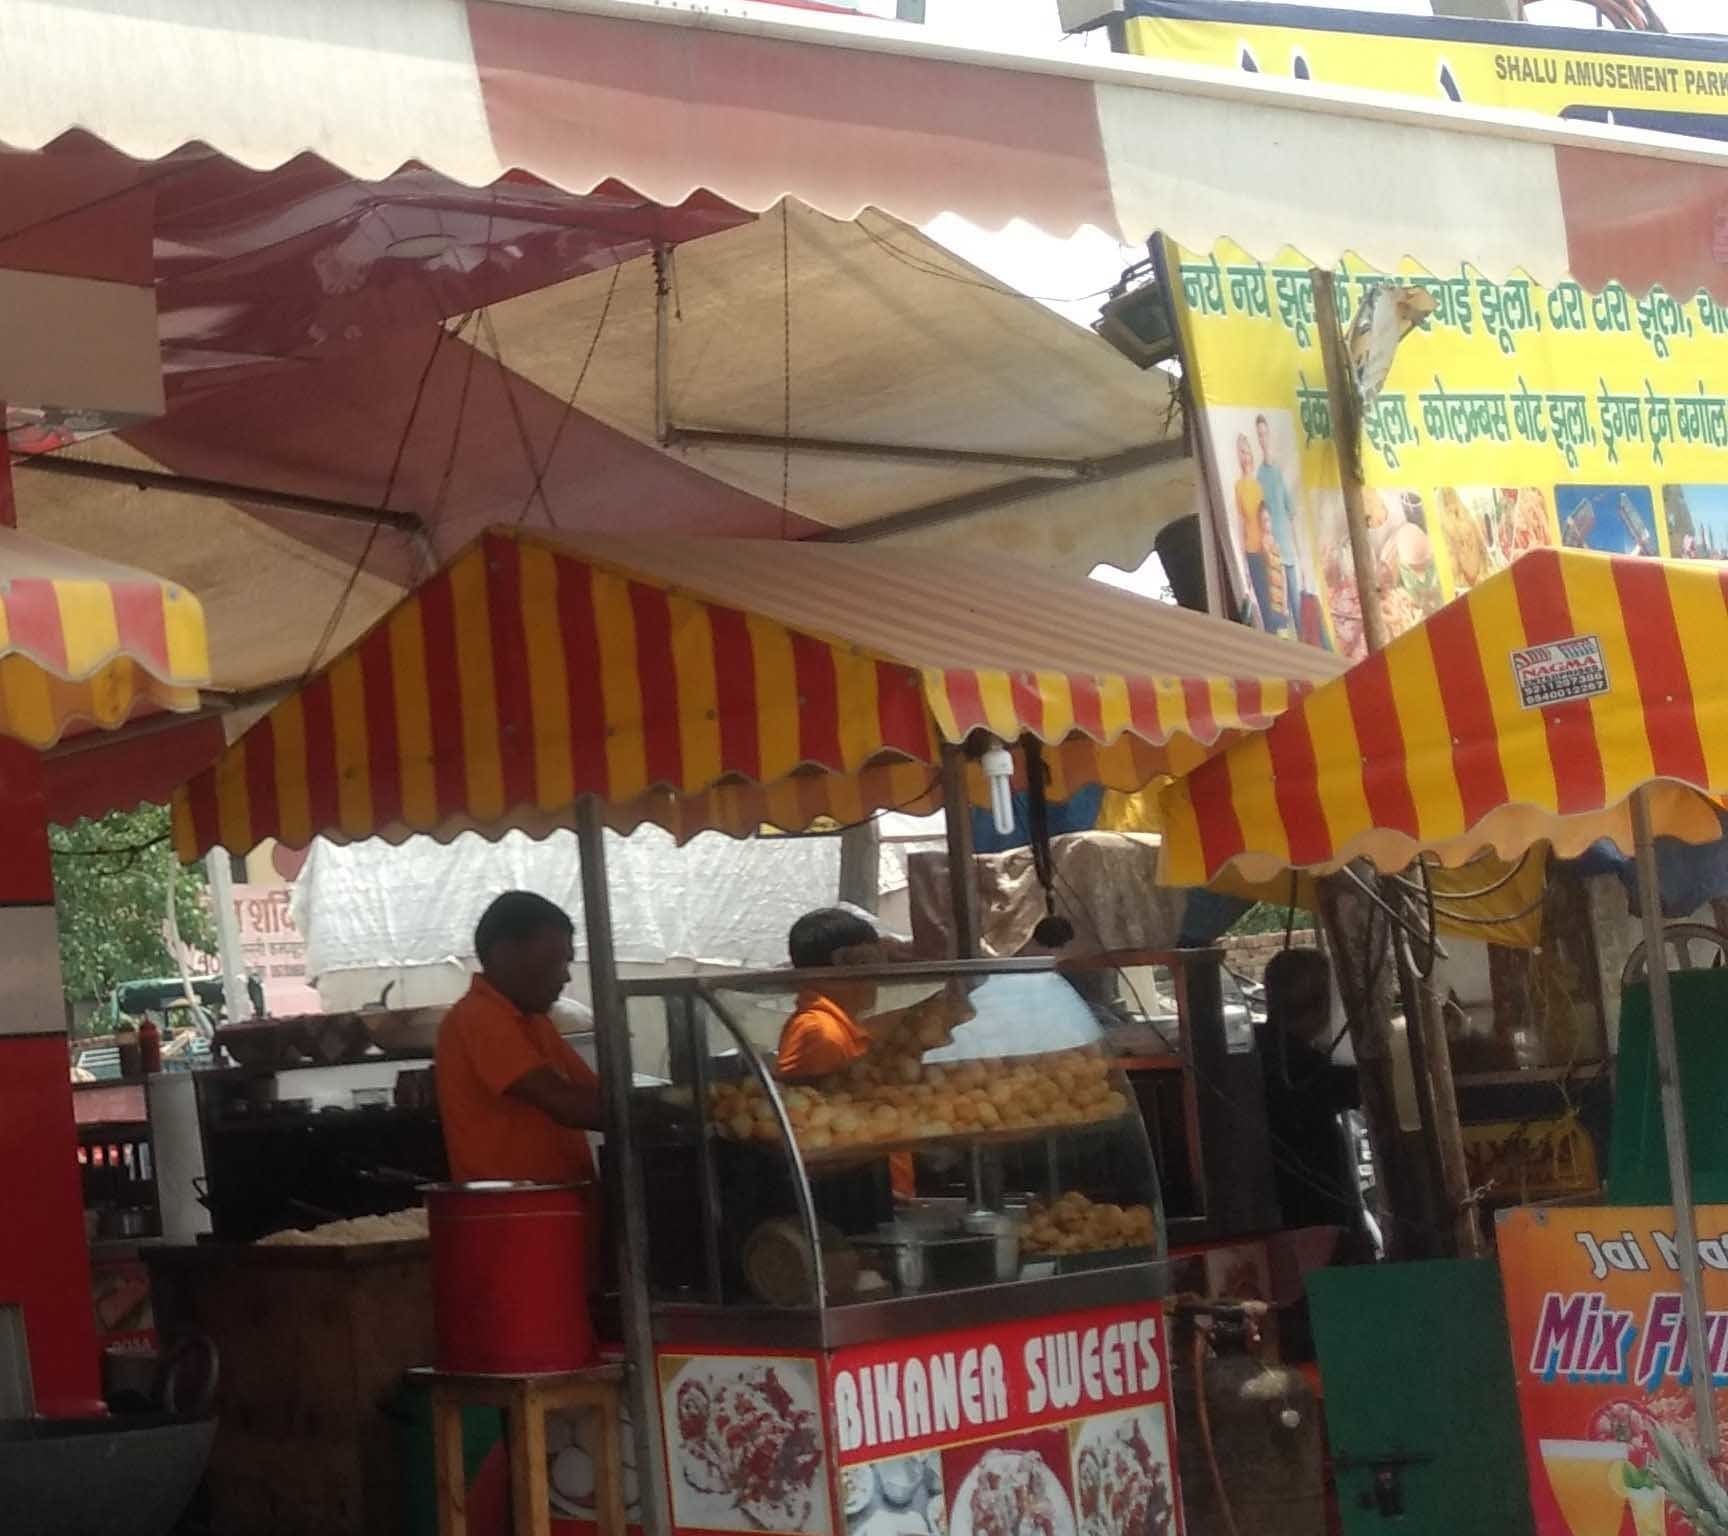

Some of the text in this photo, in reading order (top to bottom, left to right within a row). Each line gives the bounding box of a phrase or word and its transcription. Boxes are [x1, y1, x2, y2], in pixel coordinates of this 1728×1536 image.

[1495, 54, 1557, 84] SHALU
[1564, 60, 1679, 94] AMUSEMENT
[1575, 1230, 1651, 1280] Jai
[1530, 1292, 1635, 1379] Mix
[834, 1317, 1161, 1451] BIKANER SWEETS
